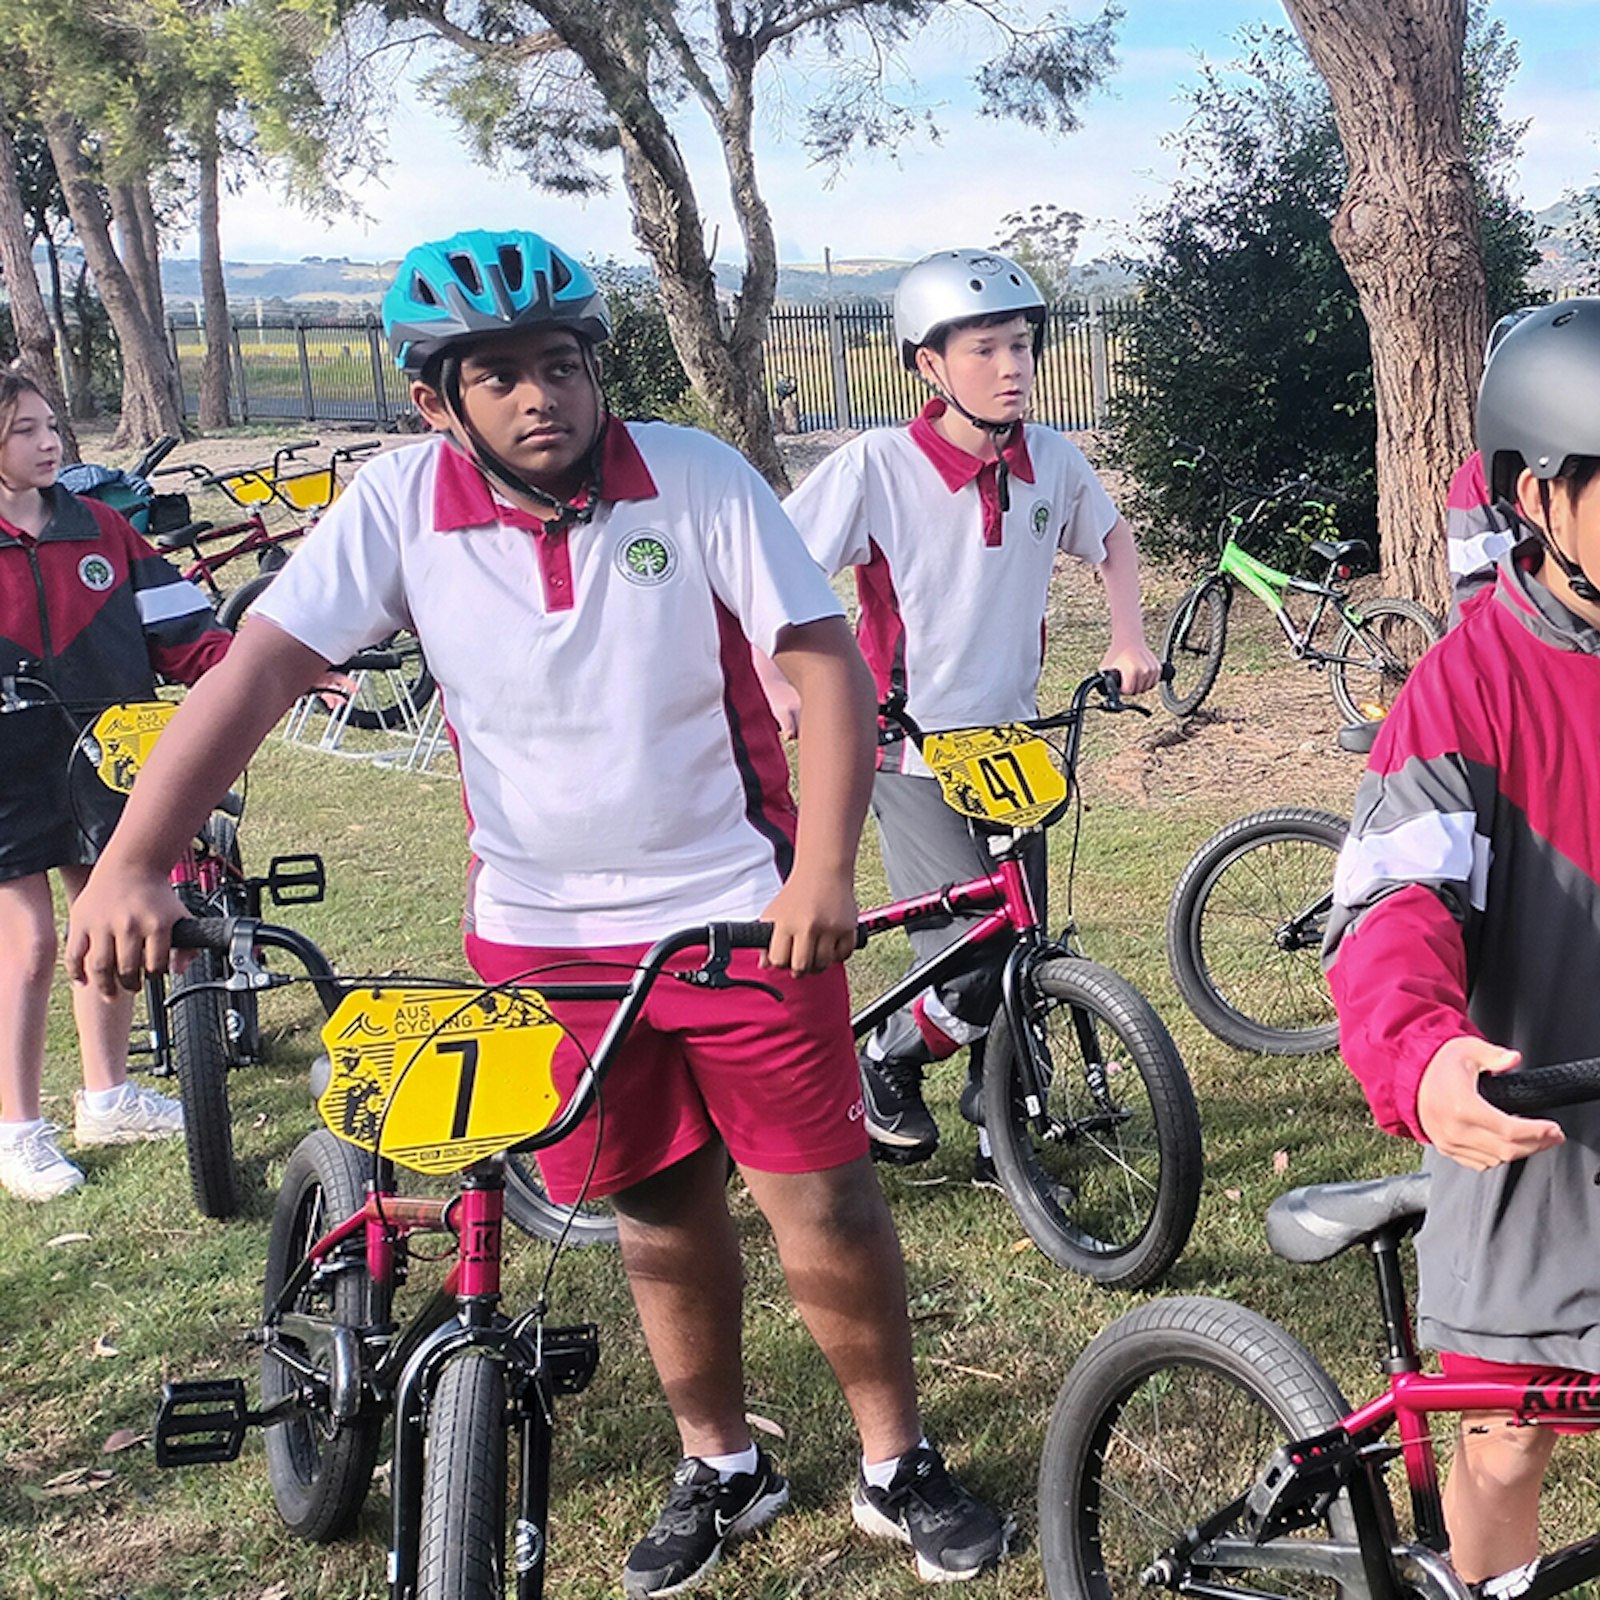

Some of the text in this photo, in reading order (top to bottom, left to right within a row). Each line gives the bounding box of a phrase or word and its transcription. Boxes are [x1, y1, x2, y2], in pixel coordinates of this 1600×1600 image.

[978, 751, 1037, 810] 47
[395, 1004, 431, 1020] AUS
[395, 1014, 473, 1035] CYCLNG
[436, 1038, 478, 1140] 7
